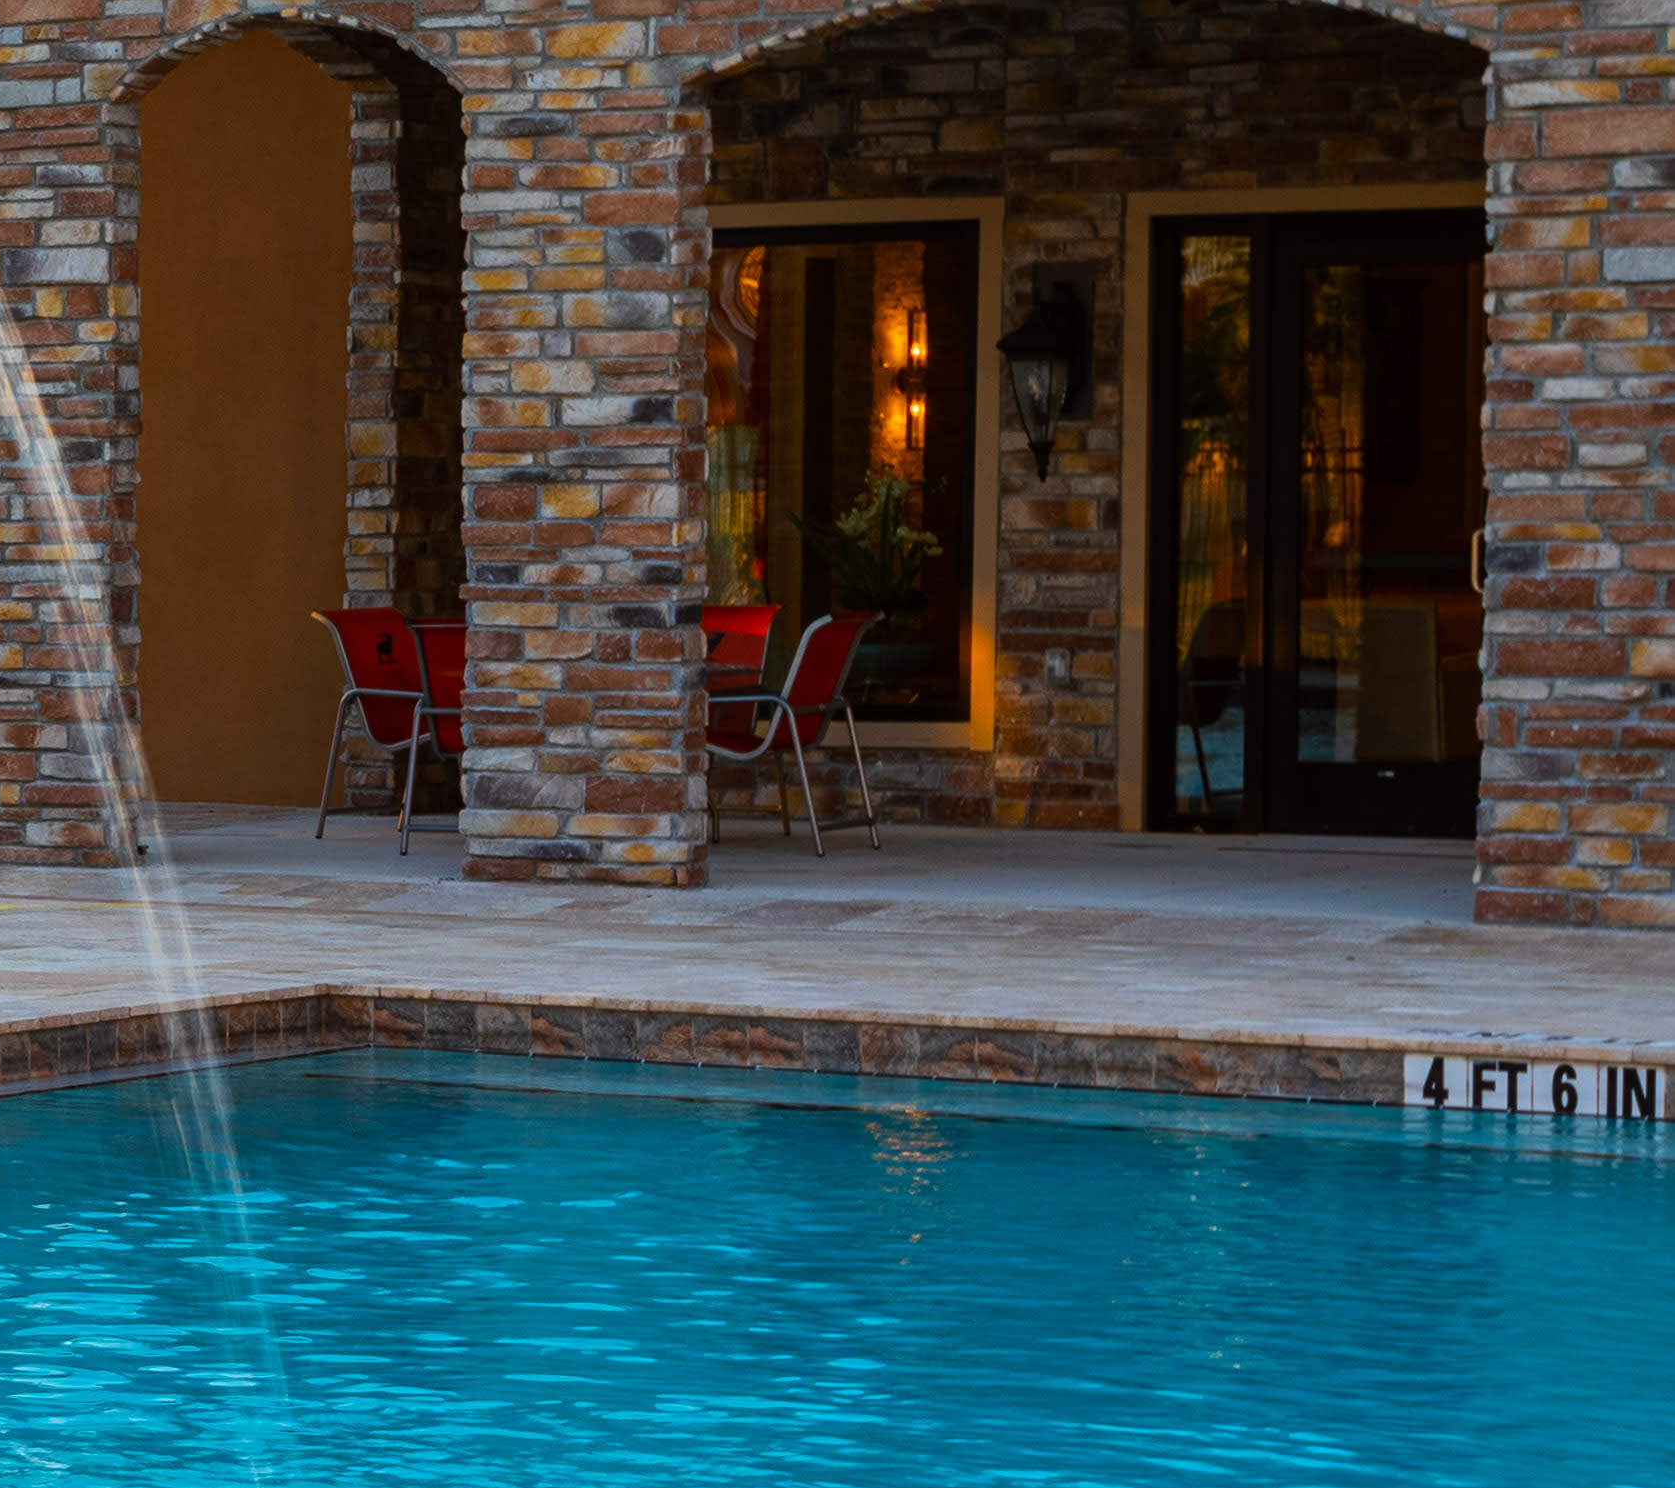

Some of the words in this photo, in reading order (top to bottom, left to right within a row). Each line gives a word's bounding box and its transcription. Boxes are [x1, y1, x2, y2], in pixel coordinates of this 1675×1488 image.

[1423, 1057, 1449, 1110] 4
[1472, 1060, 1528, 1113] FT
[1552, 1064, 1578, 1115] 6
[1607, 1066, 1656, 1119] IN
